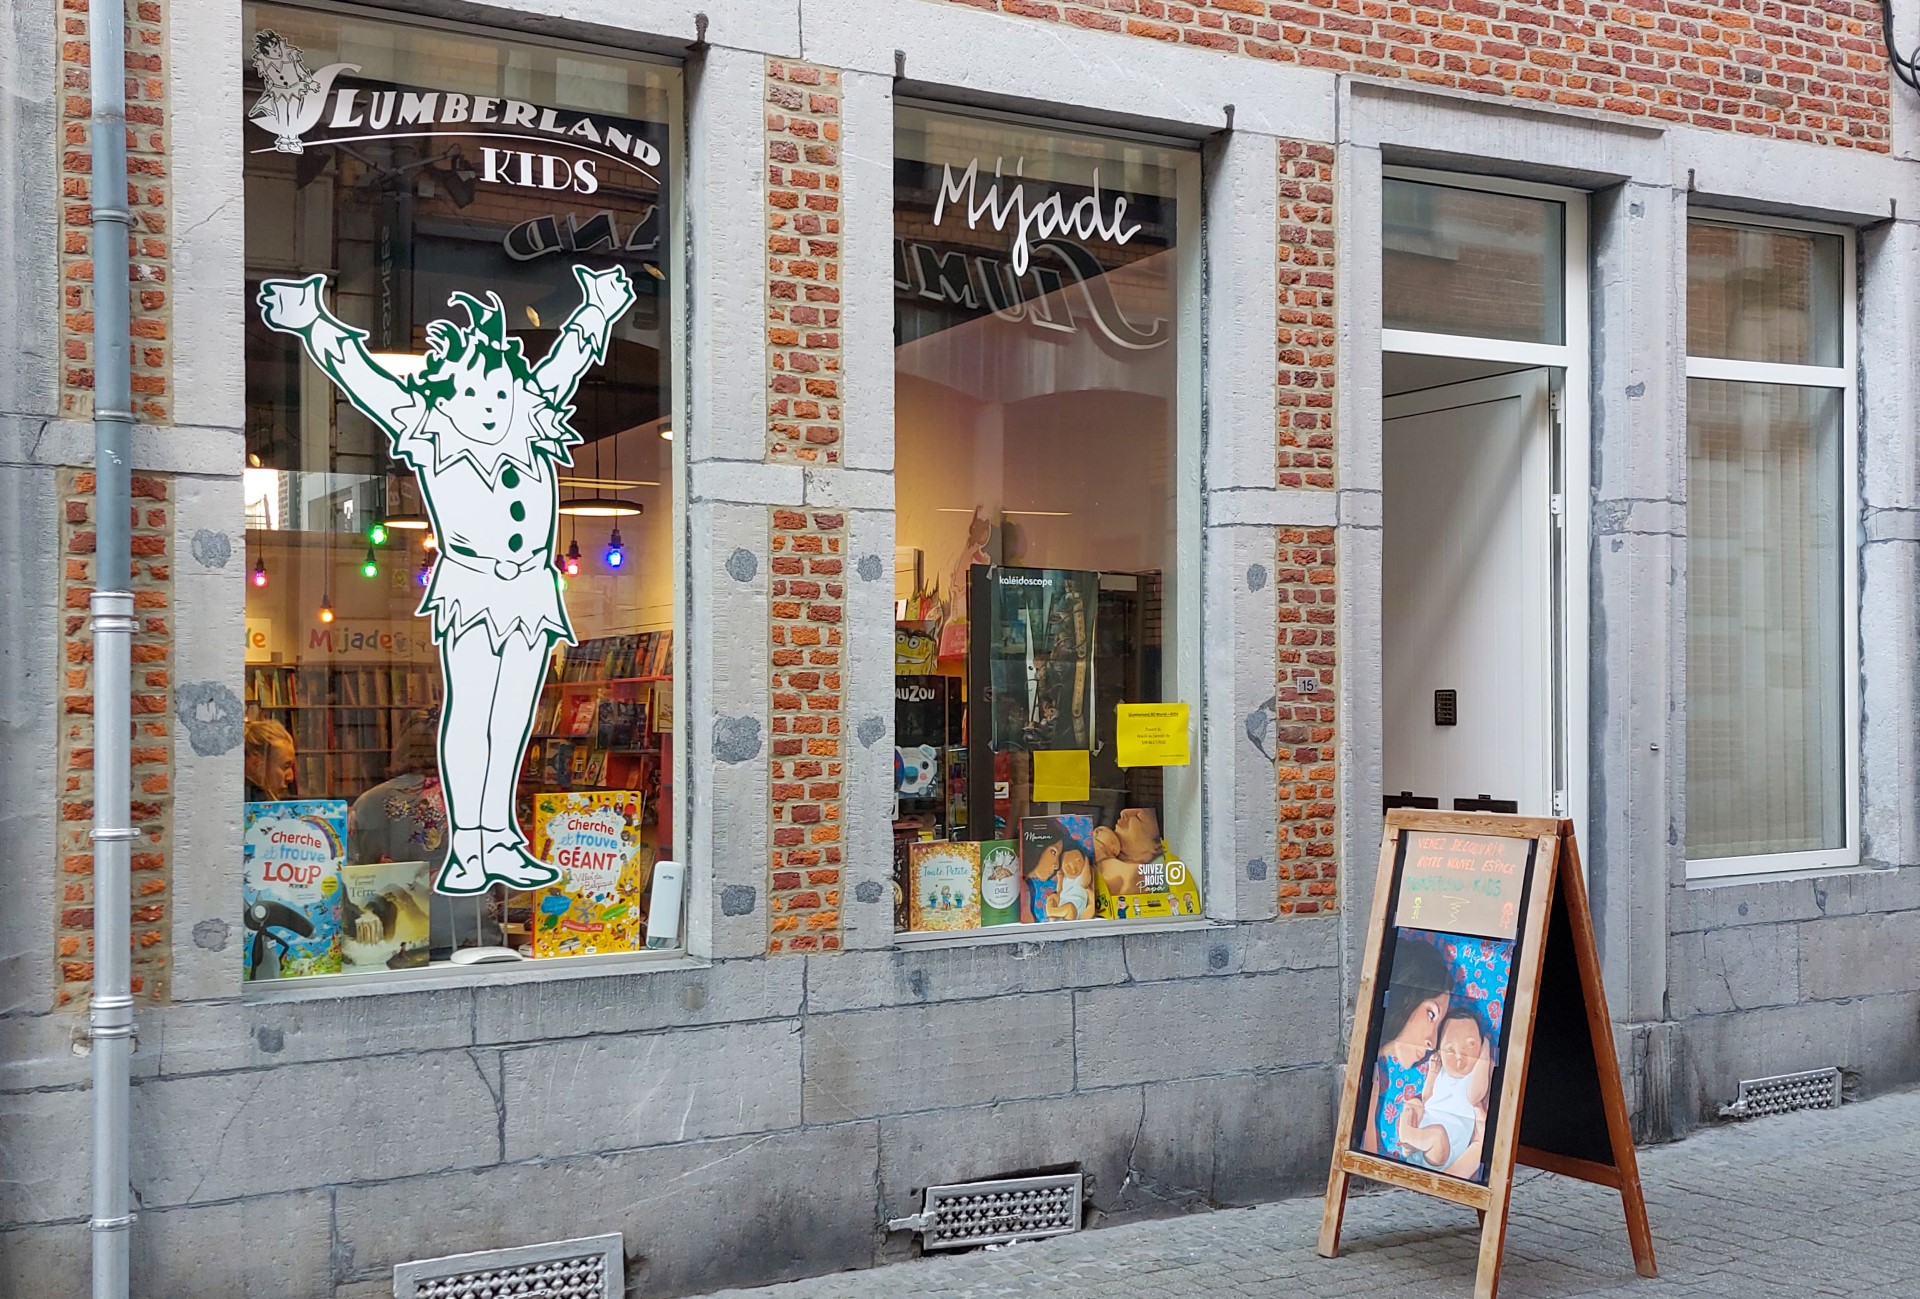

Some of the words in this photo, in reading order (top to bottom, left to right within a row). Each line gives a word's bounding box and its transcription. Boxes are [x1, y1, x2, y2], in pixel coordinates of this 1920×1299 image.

[479, 146, 599, 195] KIDS
[933, 156, 1142, 277] Mijade
[999, 575, 1053, 588] kaléidoscope
[1302, 679, 1314, 692] 15
[567, 819, 614, 835] Cherche
[271, 831, 322, 849] Cherche
[560, 833, 574, 846] et
[575, 833, 618, 849] trouve
[1418, 837, 1447, 850] VENEZ
[279, 844, 326, 863] trouve
[558, 846, 617, 871] GÉANT
[263, 862, 322, 884] LOUP
[1138, 863, 1164, 875] SUIVEZ
[1481, 859, 1517, 875] ESPACE
[1144, 875, 1164, 886] NOUS
